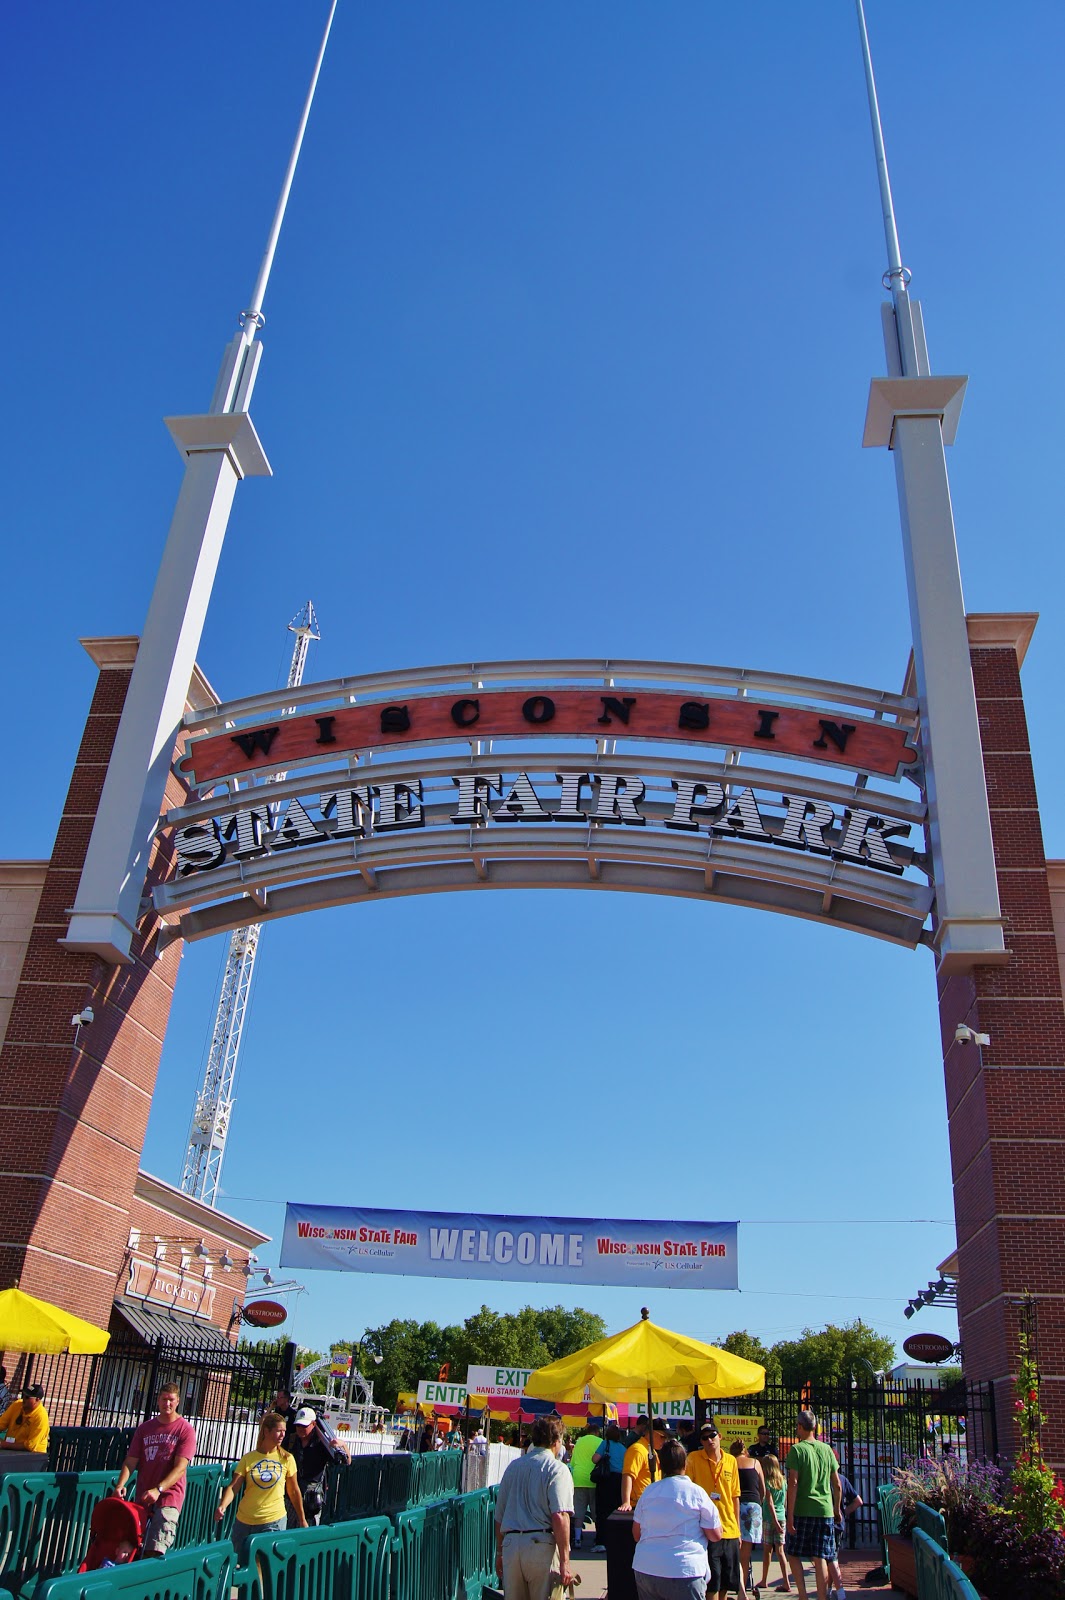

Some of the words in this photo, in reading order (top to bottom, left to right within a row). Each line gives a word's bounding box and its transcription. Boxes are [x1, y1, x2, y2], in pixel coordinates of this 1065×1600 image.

[231, 695, 856, 760] WISCONSIN
[174, 779, 425, 876] STATE
[450, 772, 646, 826] FAIR
[664, 778, 912, 876] PARK
[359, 1227, 391, 1244] STATE
[393, 1229, 417, 1246] FAIR
[369, 1249, 394, 1257] Cellular
[429, 1228, 583, 1266] WELCOME
[663, 1240, 698, 1256] STATE
[701, 1241, 726, 1257] FAIR
[676, 1262, 703, 1270] Cellular
[154, 1278, 198, 1303] TICKETS
[247, 1308, 283, 1319] RESTROOMS
[908, 1343, 949, 1351] RESTROOMS
[495, 1369, 531, 1387] EXIT
[476, 1386, 495, 1395] HAND
[496, 1387, 524, 1397] STAMP
[720, 1418, 749, 1426] WELCOME
[143, 1433, 179, 1446] WISCONSIN
[144, 1445, 159, 1462] W
